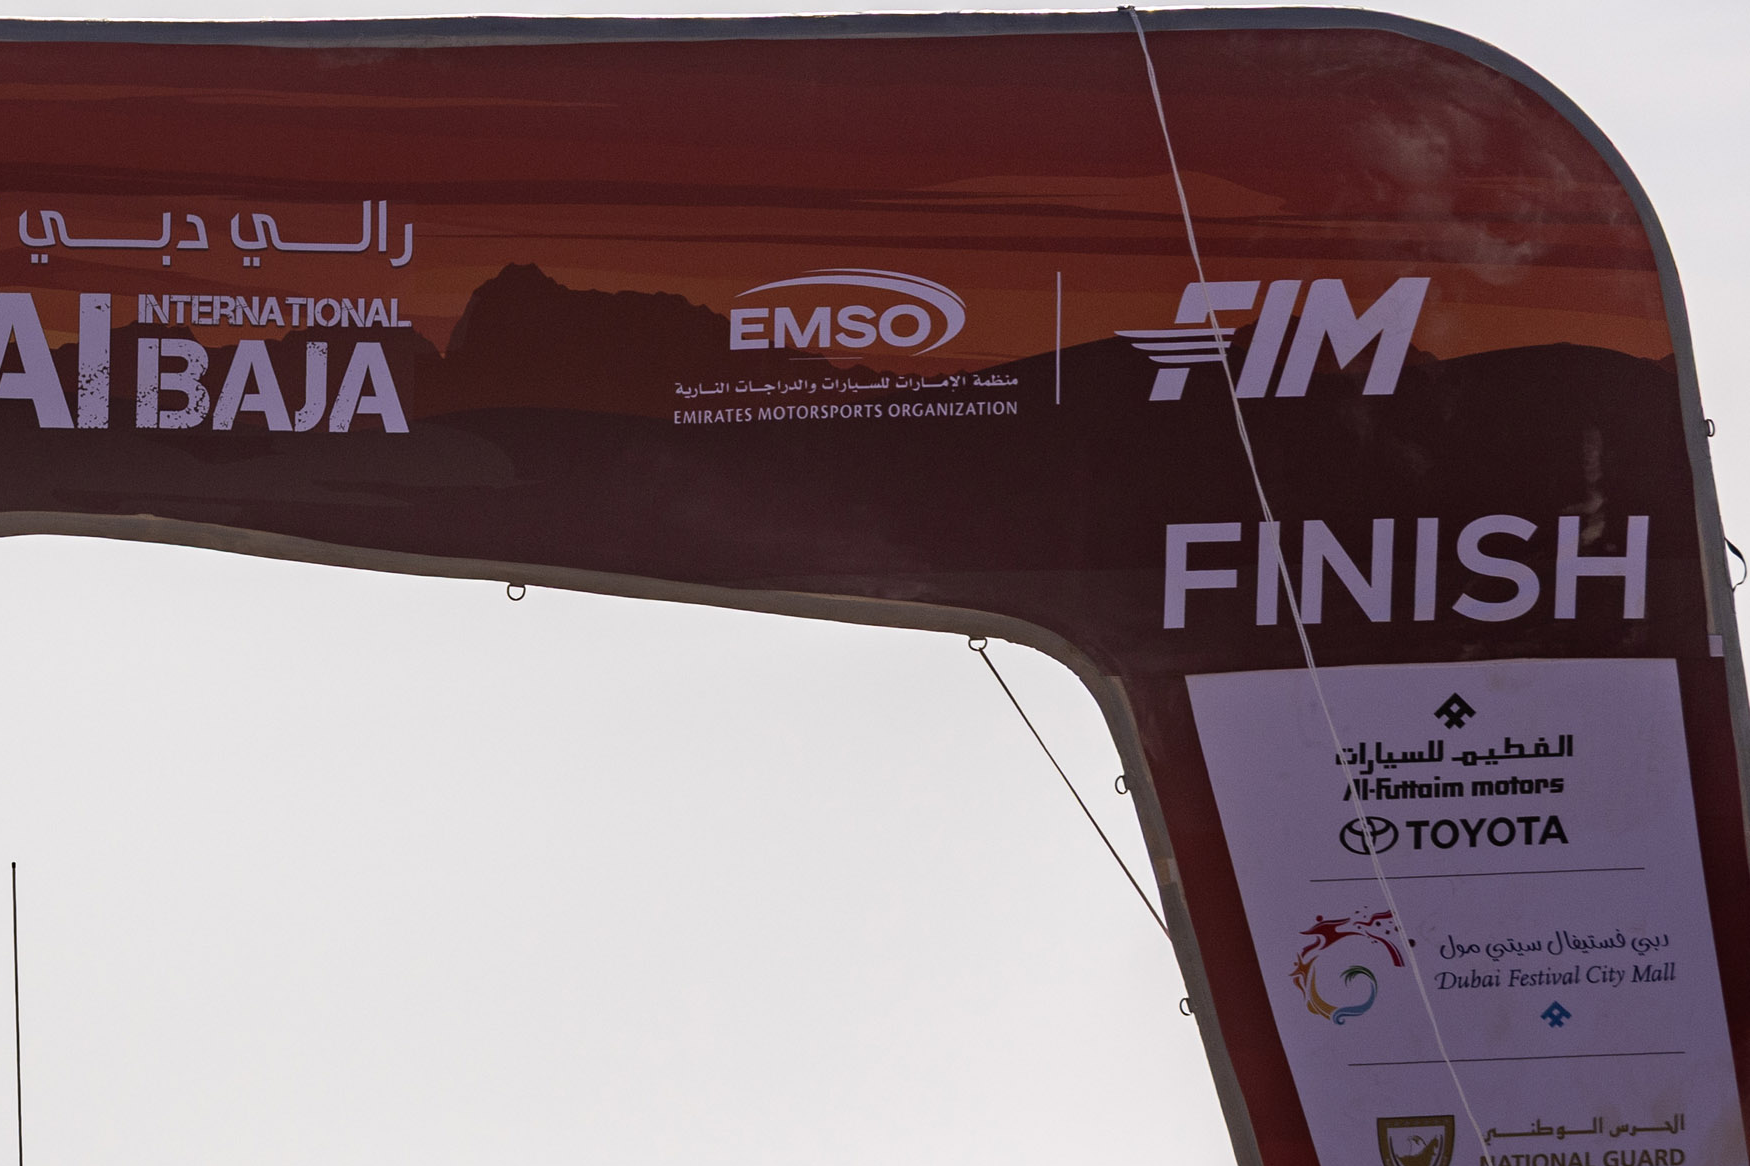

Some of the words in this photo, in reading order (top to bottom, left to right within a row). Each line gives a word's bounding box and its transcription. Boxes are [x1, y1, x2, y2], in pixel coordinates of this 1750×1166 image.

[19, 211, 208, 265] دبي
[231, 200, 412, 266] رالي
[138, 294, 411, 327] INTERNATIONAL
[729, 304, 932, 351] EMSO
[136, 338, 409, 433] BAJA
[675, 383, 729, 398] النارية
[735, 379, 816, 395] والدراجات
[822, 378, 890, 392] للسيارات
[973, 375, 1018, 386] منظمة
[674, 408, 752, 424] EMIRATES
[758, 404, 882, 420] MOTORSPORTS
[888, 401, 1017, 417] ORGANIZATION
[1163, 514, 1650, 629] FINISH
[1336, 740, 1444, 775] للسيارات
[1452, 735, 1573, 766] الفطيم
[1472, 776, 1564, 796] motors
[1406, 815, 1568, 849] TOYOTA
[1440, 935, 1480, 959] مول
[1485, 939, 1542, 961] سيتي
[1435, 969, 1500, 989] Dubai
[1508, 965, 1580, 987] Festival
[1586, 965, 1625, 987] City
[1632, 962, 1675, 982] Mall
[1609, 1114, 1685, 1138] الحرس
